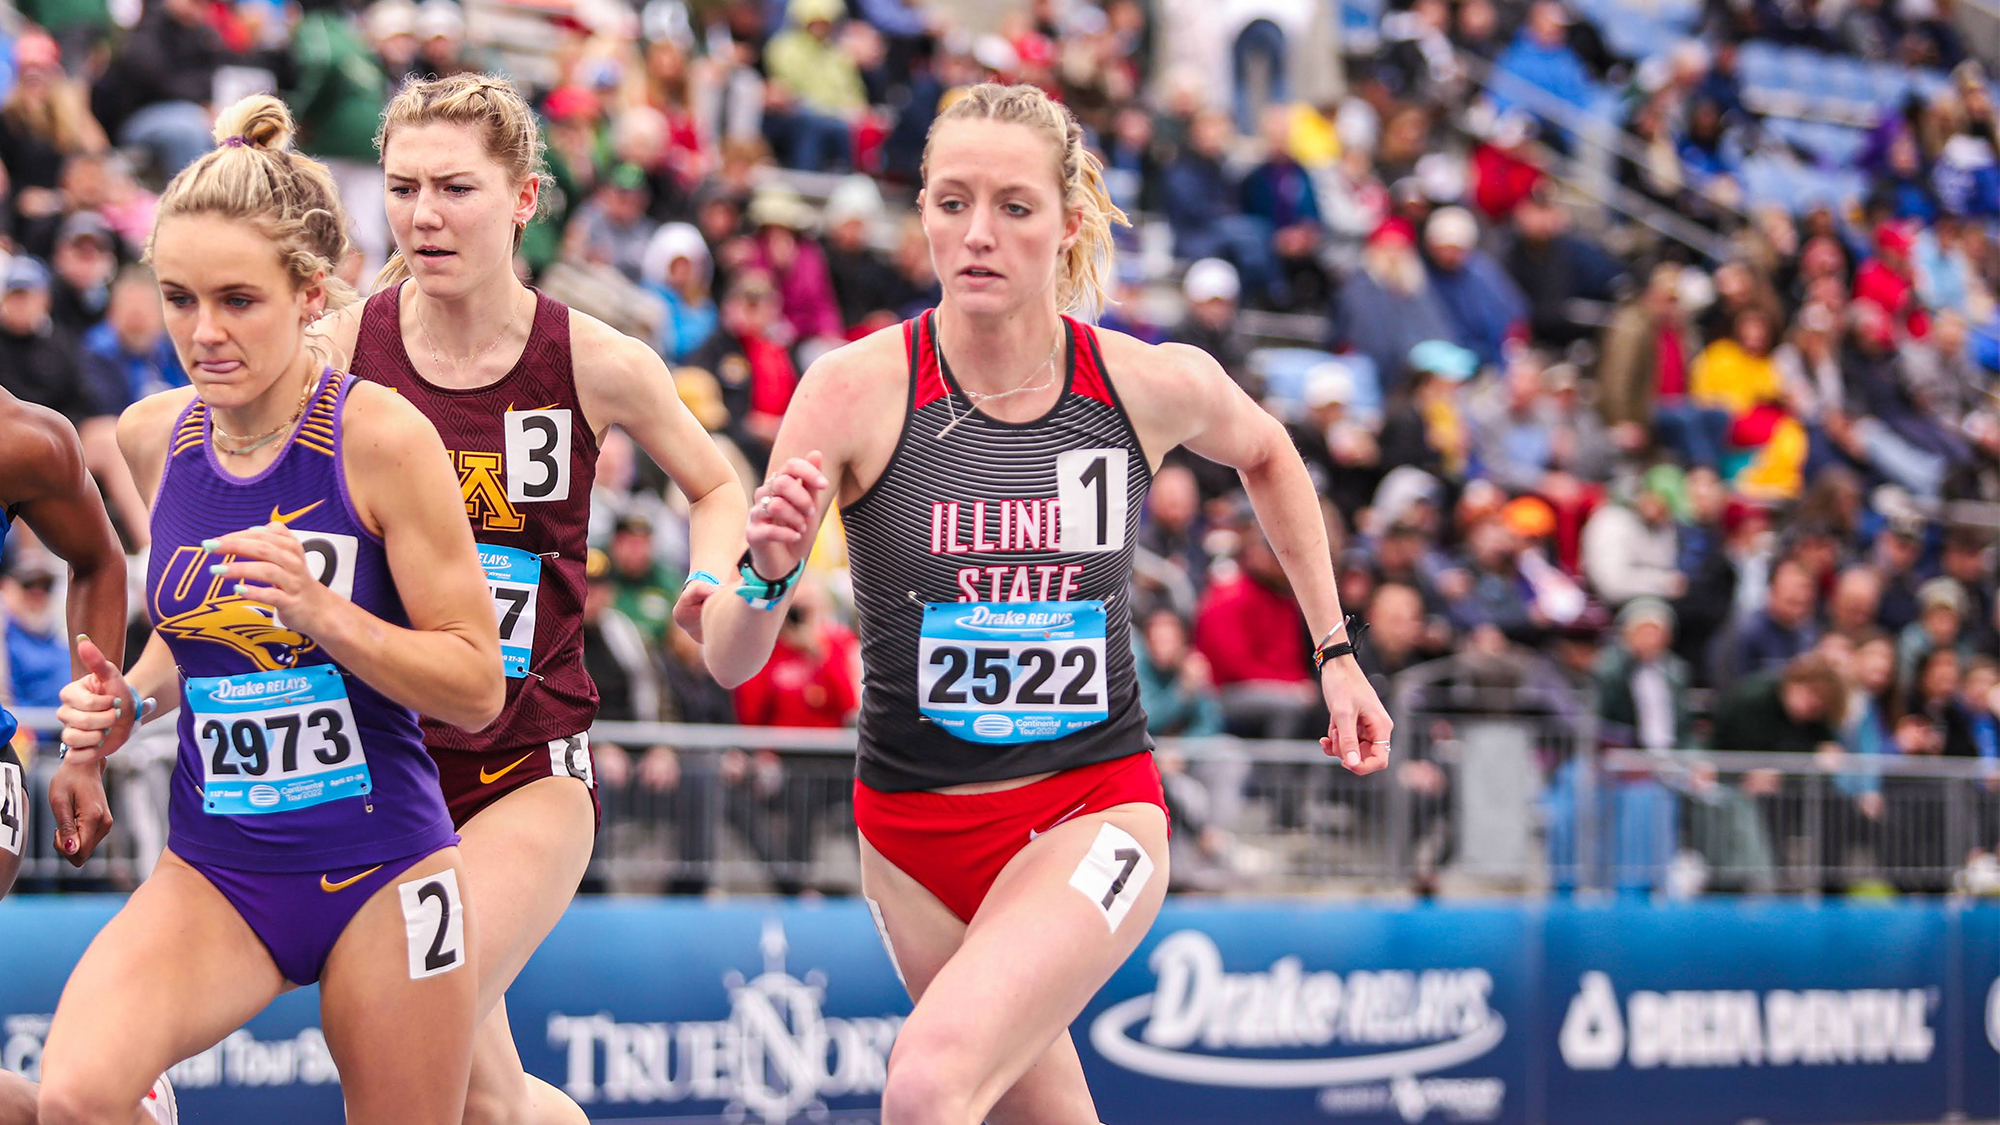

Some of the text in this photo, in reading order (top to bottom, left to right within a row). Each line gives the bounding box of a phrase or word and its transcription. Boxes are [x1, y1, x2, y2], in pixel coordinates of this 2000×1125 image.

[521, 415, 559, 498] 3
[930, 498, 1061, 555] ILLINO
[1079, 455, 1108, 547] 1
[479, 552, 509, 567] ELAYS
[957, 563, 1084, 603] STATE
[490, 586, 530, 641] 7
[970, 605, 1075, 627] Drake RELAYS
[217, 676, 308, 699] Drake RELAYS
[928, 645, 1099, 706] 2522
[202, 707, 351, 777] 2973
[1016, 719, 1061, 728] Continental
[1020, 727, 1036, 735] Tour
[1, 766, 20, 847] 4
[280, 780, 324, 796] Continental
[1100, 847, 1142, 912] 1
[417, 880, 457, 971] 2
[1142, 930, 1344, 1048] Drake
